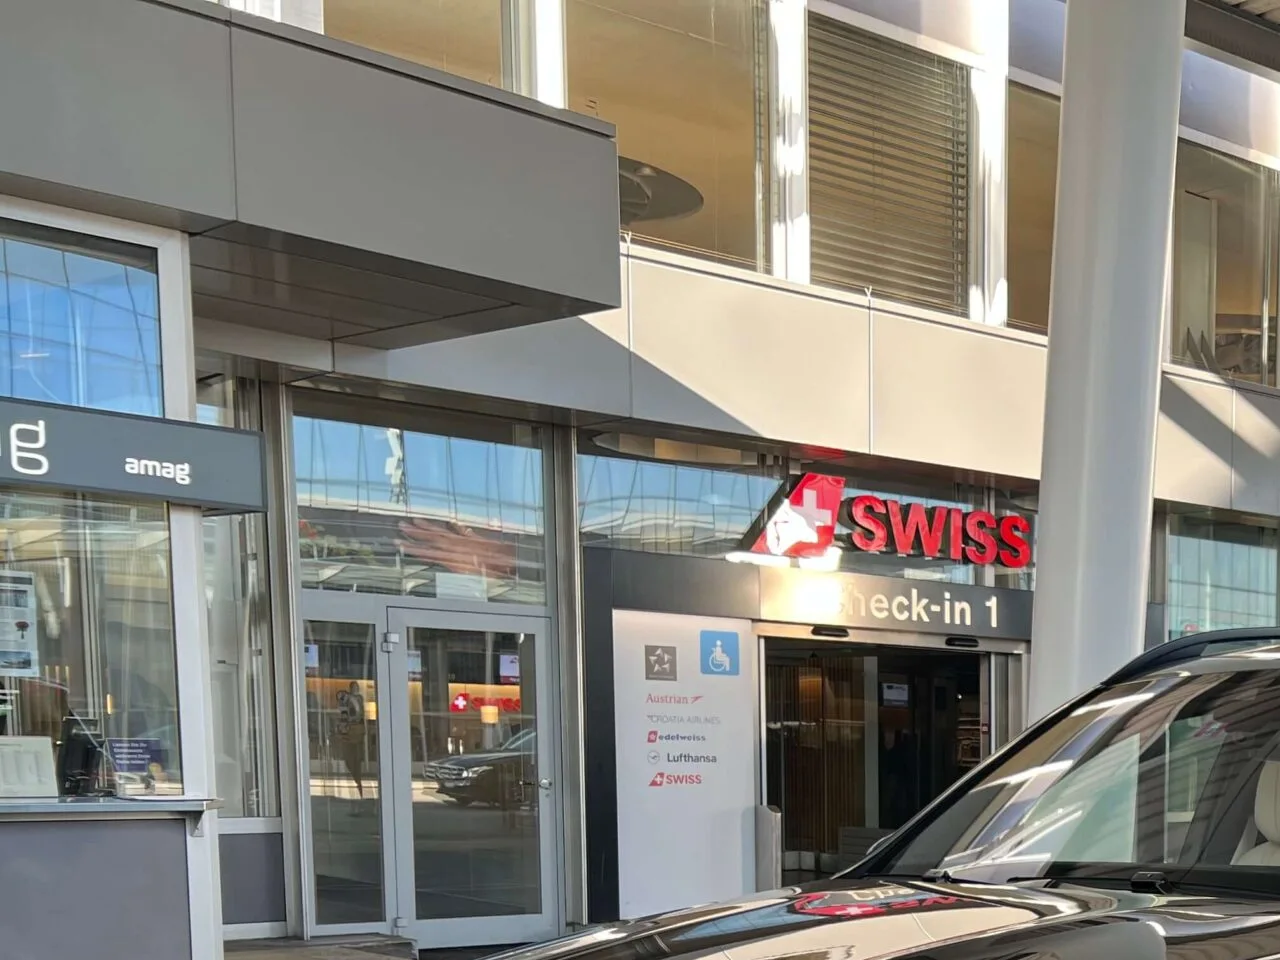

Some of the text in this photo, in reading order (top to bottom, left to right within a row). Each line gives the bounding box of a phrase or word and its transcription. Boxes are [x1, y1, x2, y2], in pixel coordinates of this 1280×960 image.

[124, 457, 192, 486] amag
[850, 494, 1031, 569] SWISS
[985, 595, 998, 628] 1
[645, 693, 689, 705] Austrian
[658, 734, 706, 742] edelweiss
[666, 752, 717, 764] Lufthansa
[666, 774, 702, 785] SWISS
